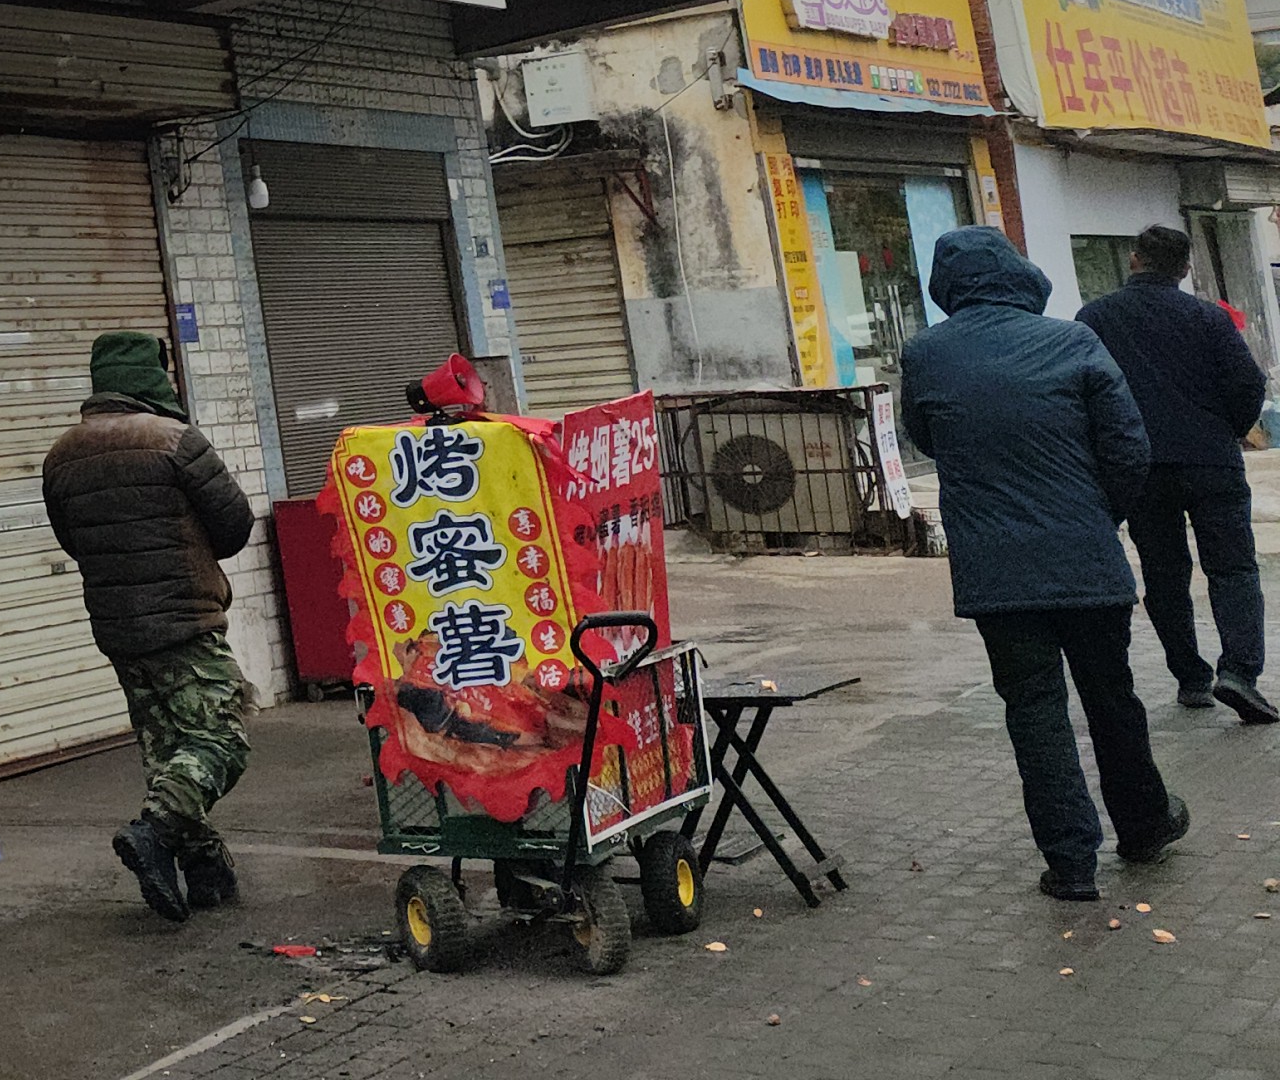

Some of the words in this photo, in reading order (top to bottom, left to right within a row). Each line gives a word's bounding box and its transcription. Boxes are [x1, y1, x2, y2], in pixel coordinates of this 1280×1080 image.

[1045, 17, 1201, 131] 仕兵平价超市
[344, 455, 416, 632] 吃好的蜜薯
[389, 426, 525, 690] 烤蜜薯
[511, 508, 567, 689] 享幸福生活
